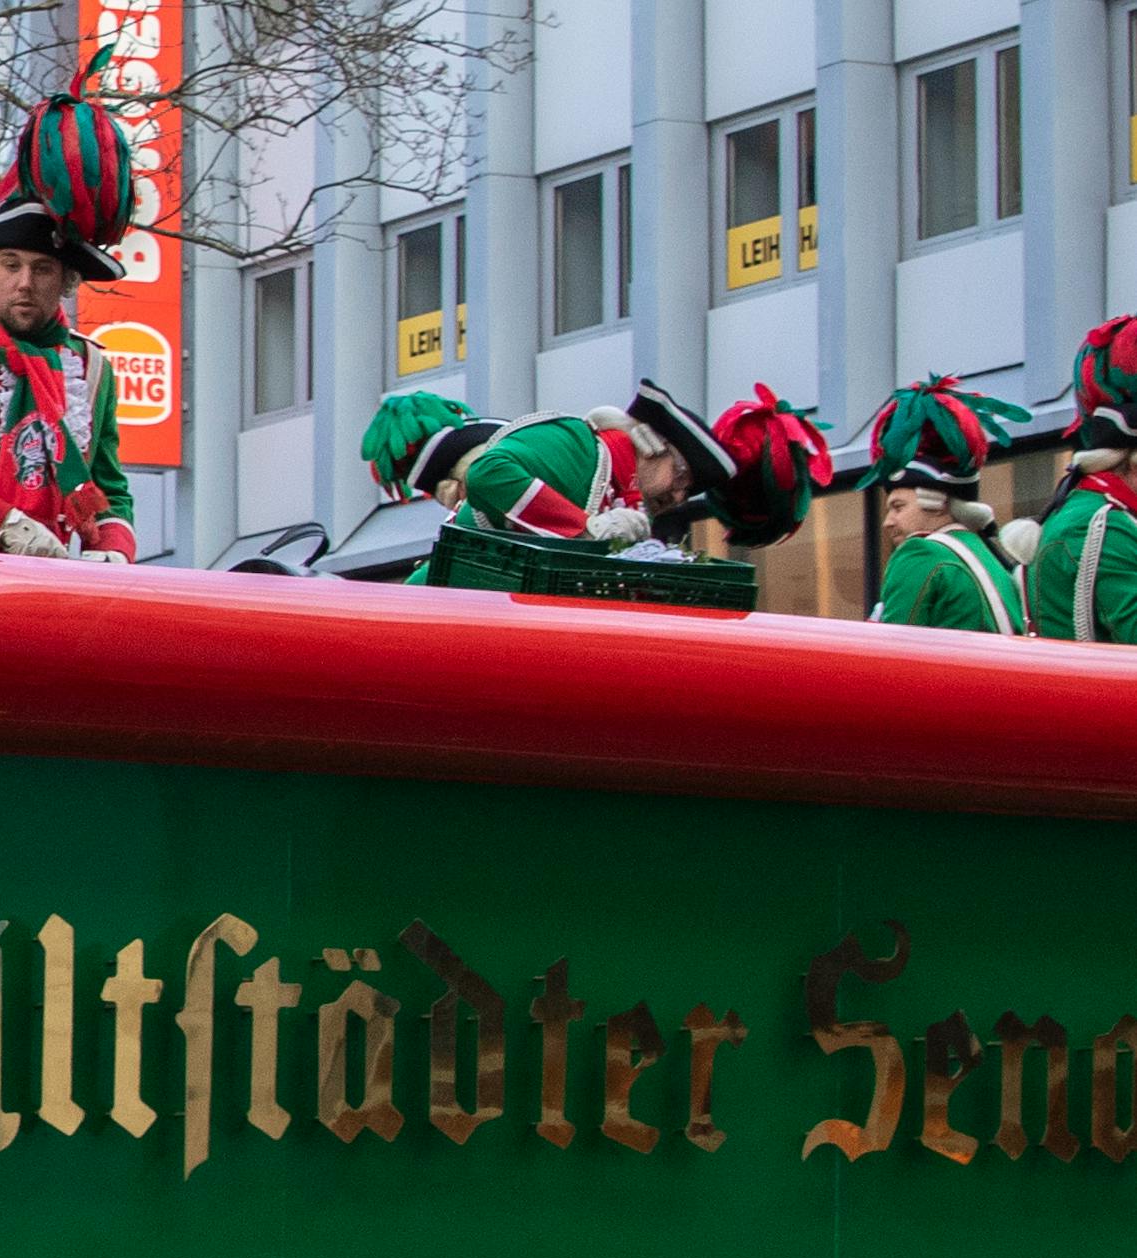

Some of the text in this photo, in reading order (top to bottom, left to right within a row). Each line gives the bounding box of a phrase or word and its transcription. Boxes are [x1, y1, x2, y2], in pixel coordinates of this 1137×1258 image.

[741, 232, 780, 269] LEIH
[409, 326, 442, 357] LEIH
[110, 355, 165, 375] RGER
[114, 375, 165, 402] ING
